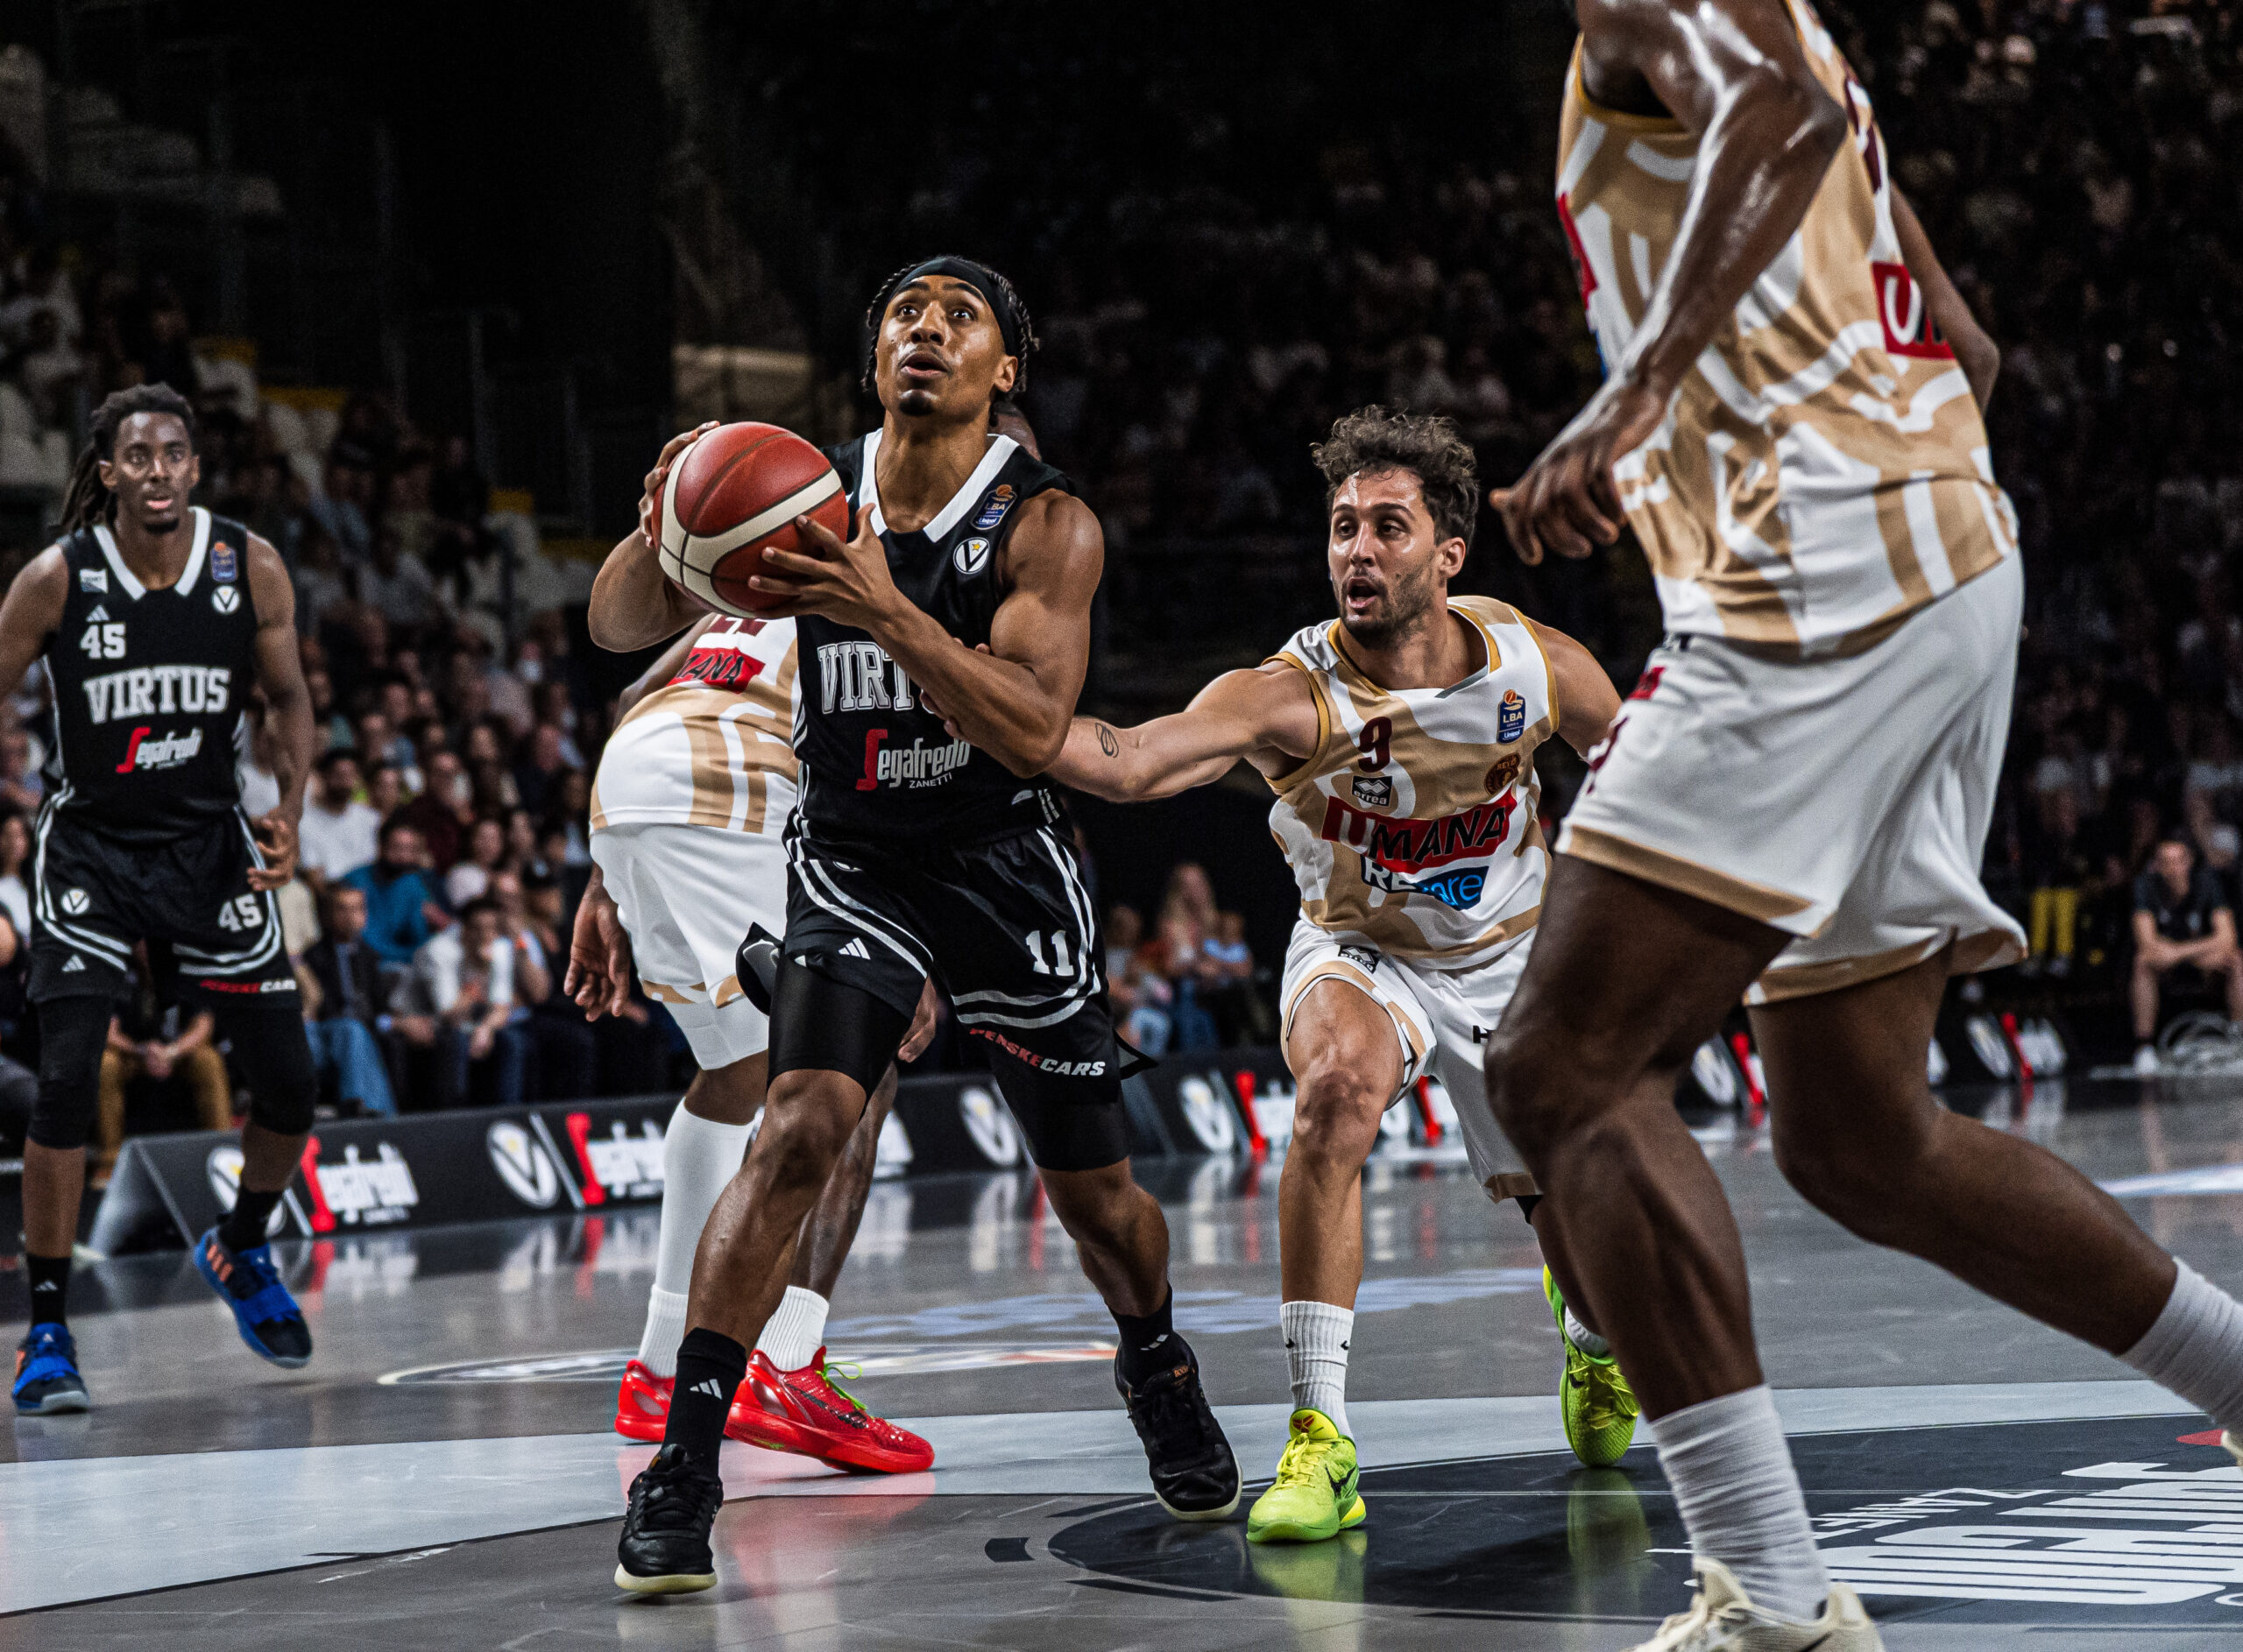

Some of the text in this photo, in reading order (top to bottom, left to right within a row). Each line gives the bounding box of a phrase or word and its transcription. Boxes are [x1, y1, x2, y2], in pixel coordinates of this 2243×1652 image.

[79, 623, 126, 660] 45
[81, 663, 231, 724] VIRTUS
[1503, 711, 1523, 724] LBA
[1358, 717, 1392, 773] 9
[909, 772, 952, 789] ZANETTI
[1338, 807, 1505, 865] UMANA
[218, 893, 263, 932] 45
[1025, 929, 1074, 977] 11
